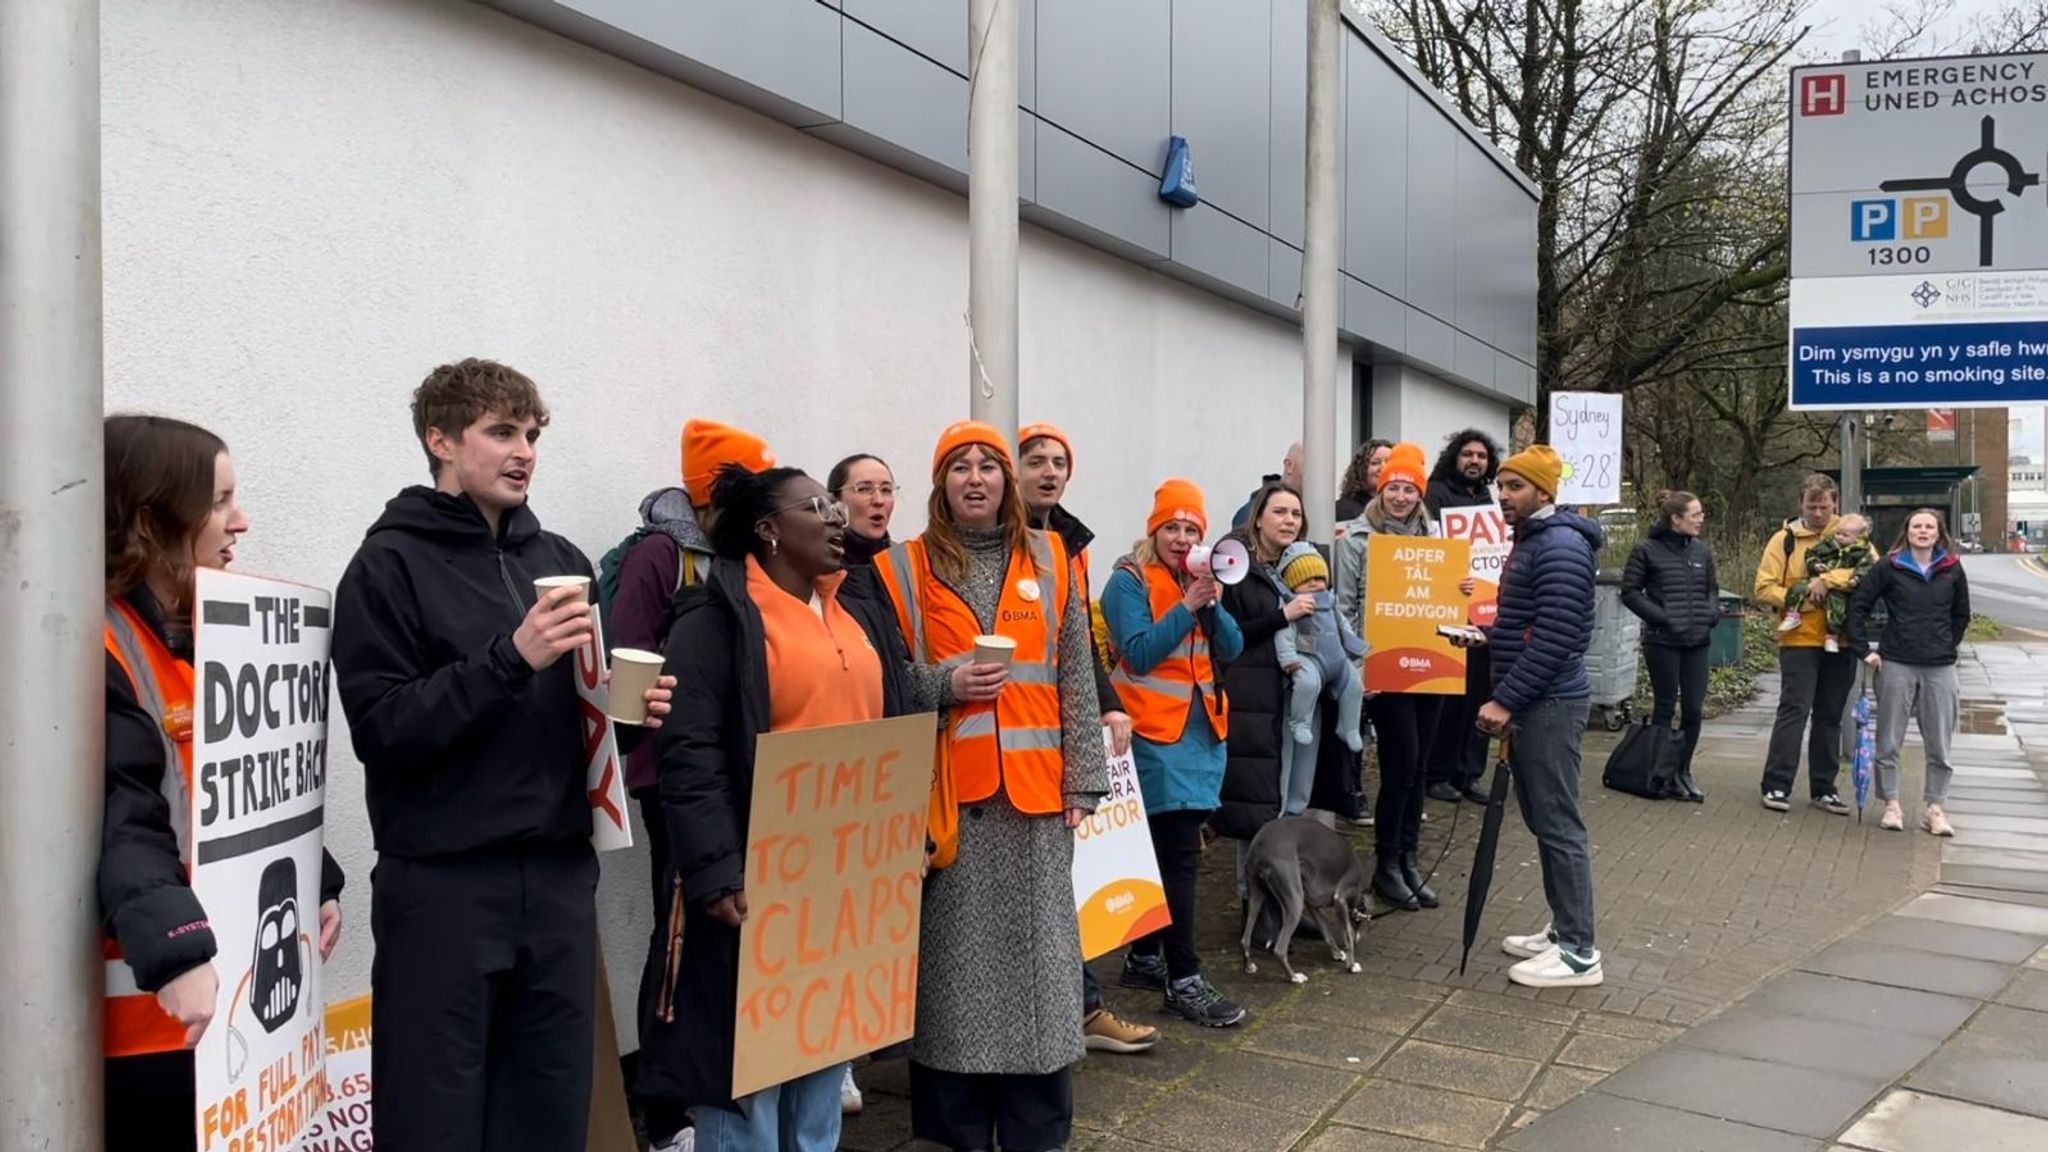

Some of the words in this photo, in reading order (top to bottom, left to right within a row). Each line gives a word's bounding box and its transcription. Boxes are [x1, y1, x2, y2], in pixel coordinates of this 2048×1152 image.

[1866, 62, 2035, 89] EMERGENCY
[1865, 90, 1940, 112] UNED
[1952, 84, 2046, 106] ACHOS
[1861, 204, 1889, 238] P
[1913, 201, 1941, 235] P
[1868, 246, 1931, 266] 1300
[1799, 345, 1836, 362] Dim
[1842, 344, 1915, 364] ysmygu
[1920, 345, 1943, 363] yn
[1949, 345, 1960, 361] y
[1966, 341, 2012, 357] safle
[2018, 340, 2048, 356] hw
[1812, 368, 1851, 384] This
[1857, 368, 1873, 383] is
[1879, 371, 1890, 383] a
[1895, 369, 1919, 383] no
[1925, 365, 2005, 386] smoking
[1555, 395, 1610, 441] Sydney
[1445, 511, 1506, 545] PAY
[1393, 547, 1446, 563] ADFER
[1404, 563, 1433, 581] TÂL
[1405, 585, 1430, 599] AM
[254, 595, 300, 645] THE
[1013, 610, 1037, 621] BMA
[1375, 602, 1459, 619] FEDDYGON
[1410, 656, 1431, 669] BMA
[203, 660, 330, 745] DOCTORS
[200, 747, 290, 827] STRIKE
[296, 738, 327, 797] BACK
[774, 750, 900, 814] TIME
[1076, 799, 1141, 840] OCTOR
[751, 834, 812, 884] TO
[832, 810, 923, 876] TURN
[753, 871, 920, 978] CLAPS
[741, 984, 792, 1031] TO
[795, 953, 917, 1057] CASH
[203, 1087, 249, 1152] FOR
[258, 1050, 298, 1113] FULL
[302, 1019, 321, 1076] PAY
